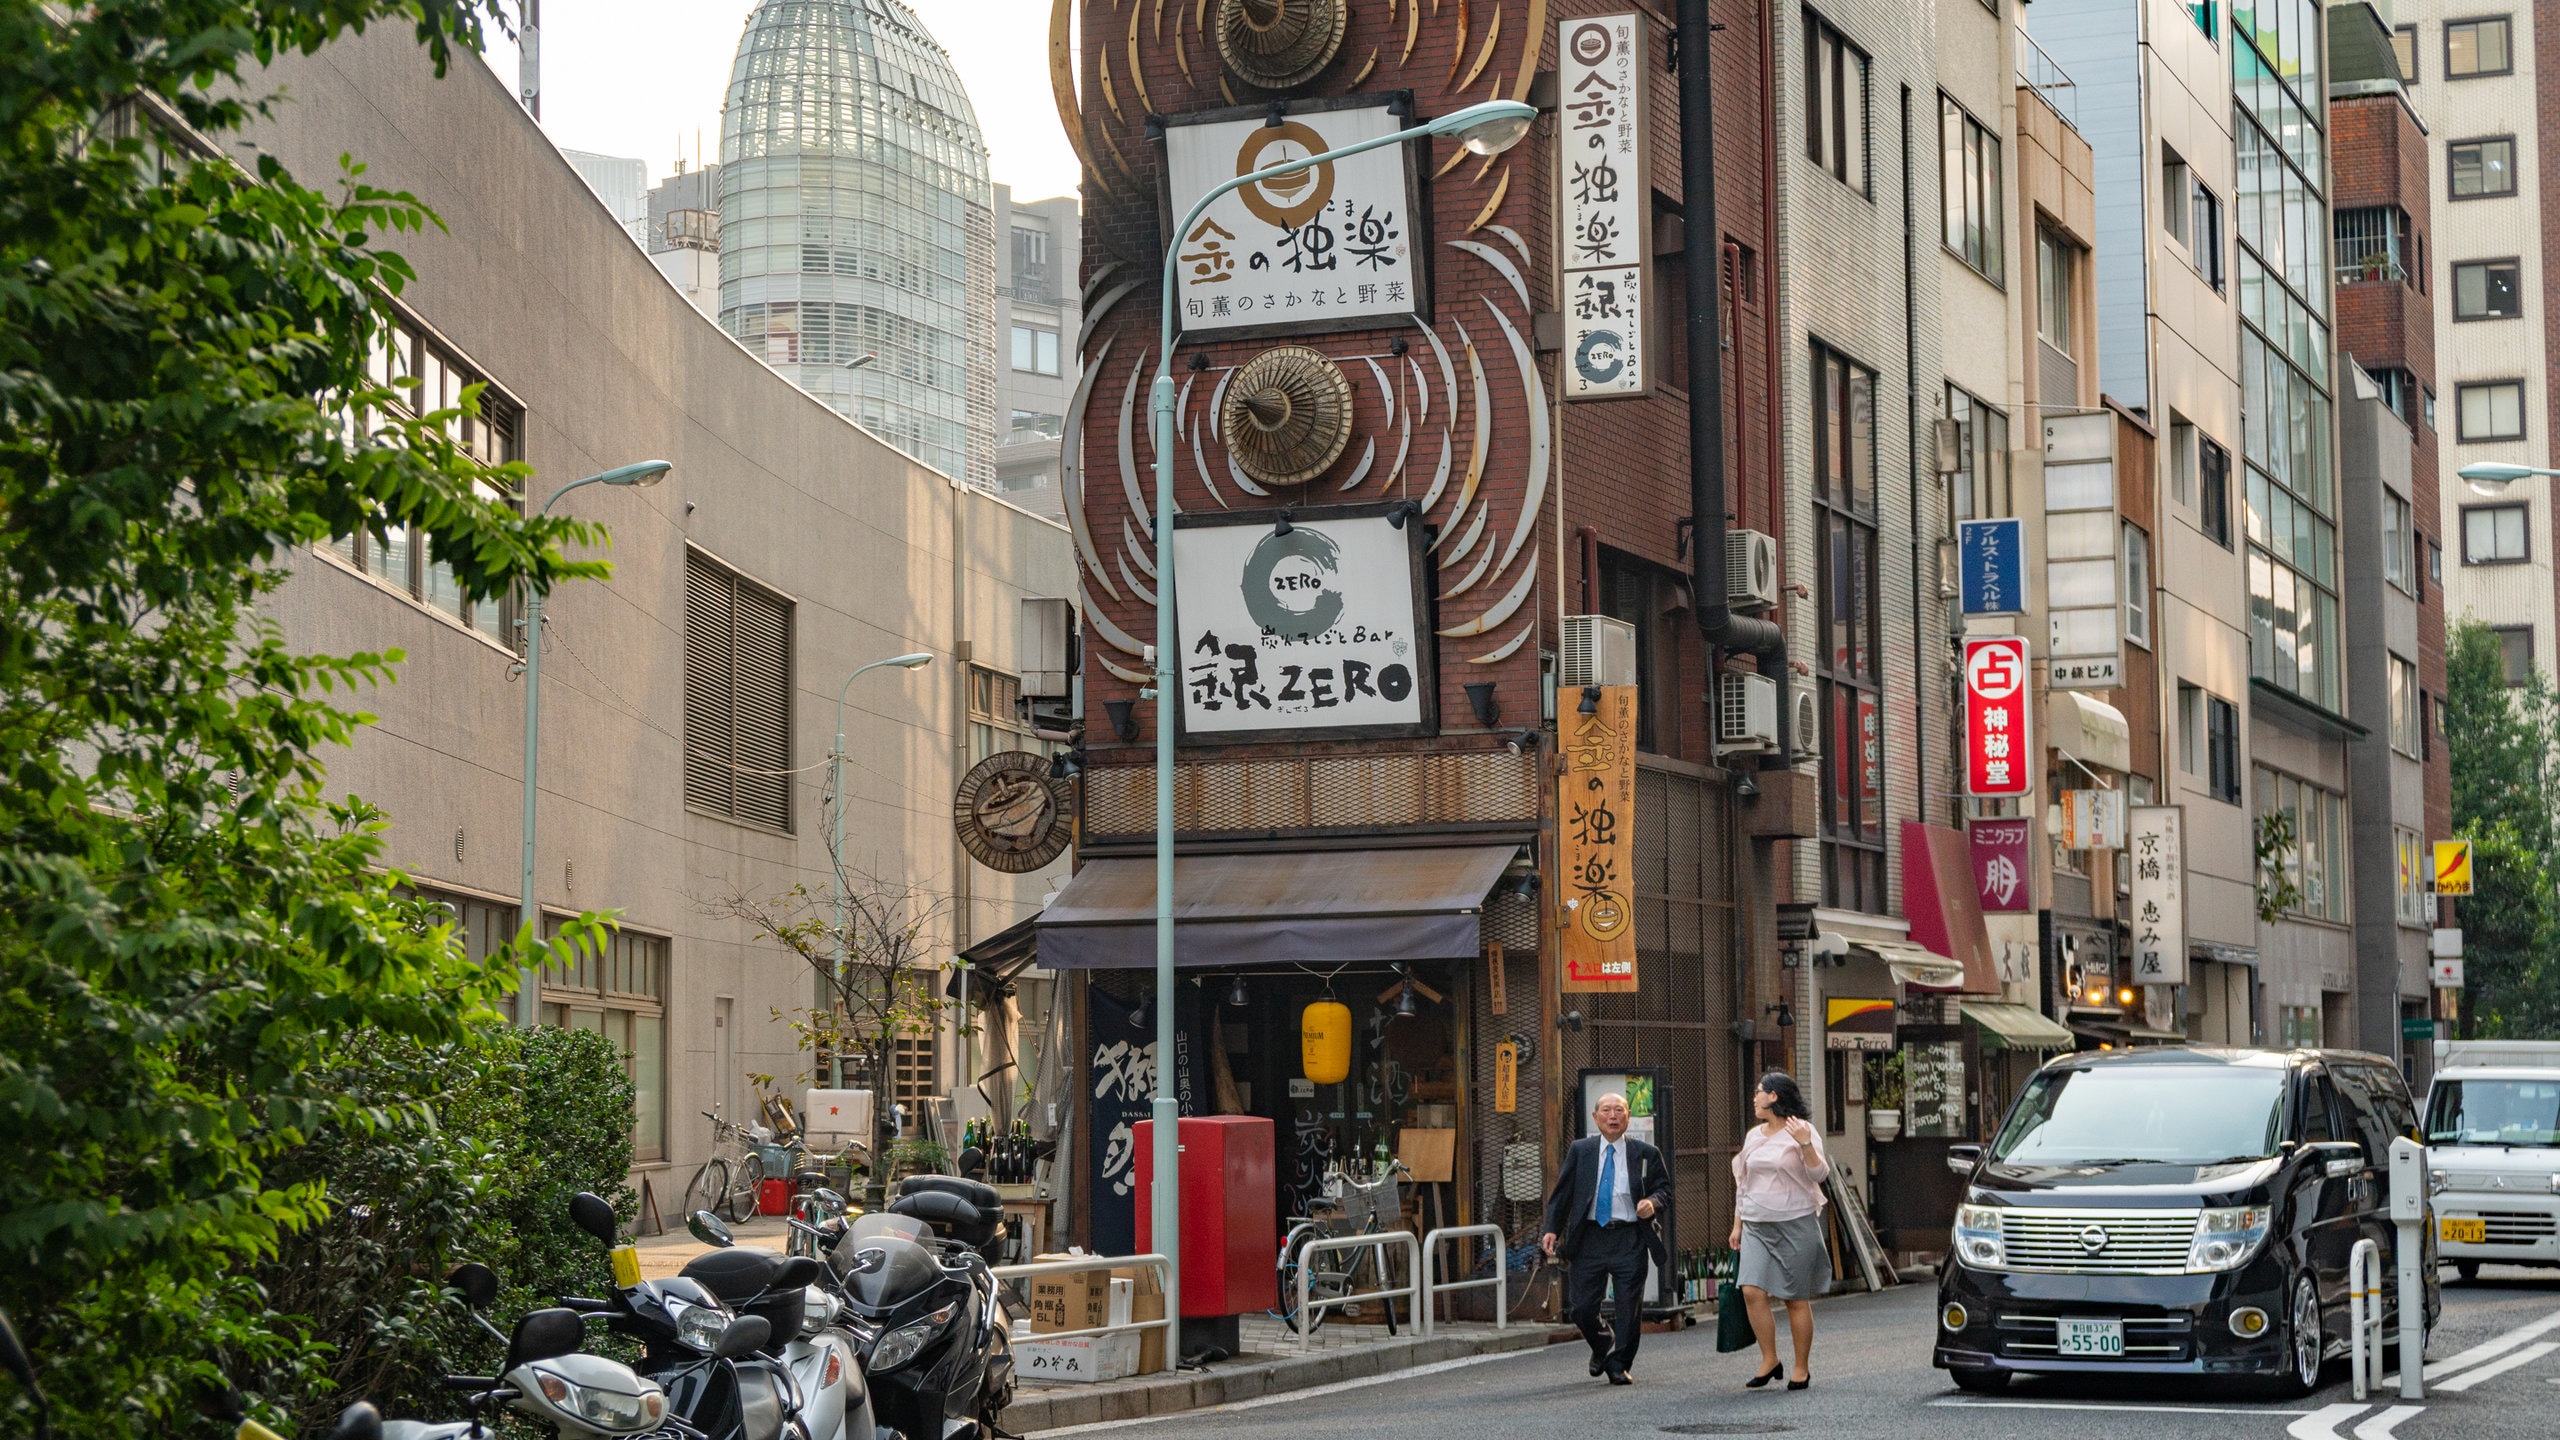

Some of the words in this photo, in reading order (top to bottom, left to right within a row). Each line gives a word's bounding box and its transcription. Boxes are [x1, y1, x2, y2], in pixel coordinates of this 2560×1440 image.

[1615, 24, 1632, 154] 旬薫のさかなと野菜
[1566, 70, 1620, 264] 金の独楽
[1328, 199, 1355, 217] こま
[1180, 204, 1399, 286] 金の独楽
[1185, 281, 1406, 318] 旬薫のさかなと野菜
[1574, 274, 1622, 320] 銀
[1590, 351, 1614, 360] ZERO
[1274, 573, 1322, 591] ZERO
[1977, 650, 2014, 691] 占
[1616, 695, 1631, 803] 旬薫のさかなと野菜
[1983, 705, 2010, 786] 神秘堂
[1565, 716, 1618, 903] 金の独楽
[1975, 827, 2026, 846] ミニクラブ
[2137, 831, 2161, 881] 京橋
[1983, 853, 2021, 907] 朋
[2436, 880, 2471, 893] からうま
[2138, 899, 2163, 975] 恵み屋
[1583, 960, 1631, 974] 入口は左側
[1176, 1030, 1194, 1117] 山口の山奥の小
[1033, 1299, 1055, 1311] 角瓶
[1037, 1285, 1065, 1296] 業務用
[1036, 1312, 1051, 1323] 5L
[2072, 1334, 2121, 1352] 55-00
[1032, 1355, 1080, 1373] のぞみ
